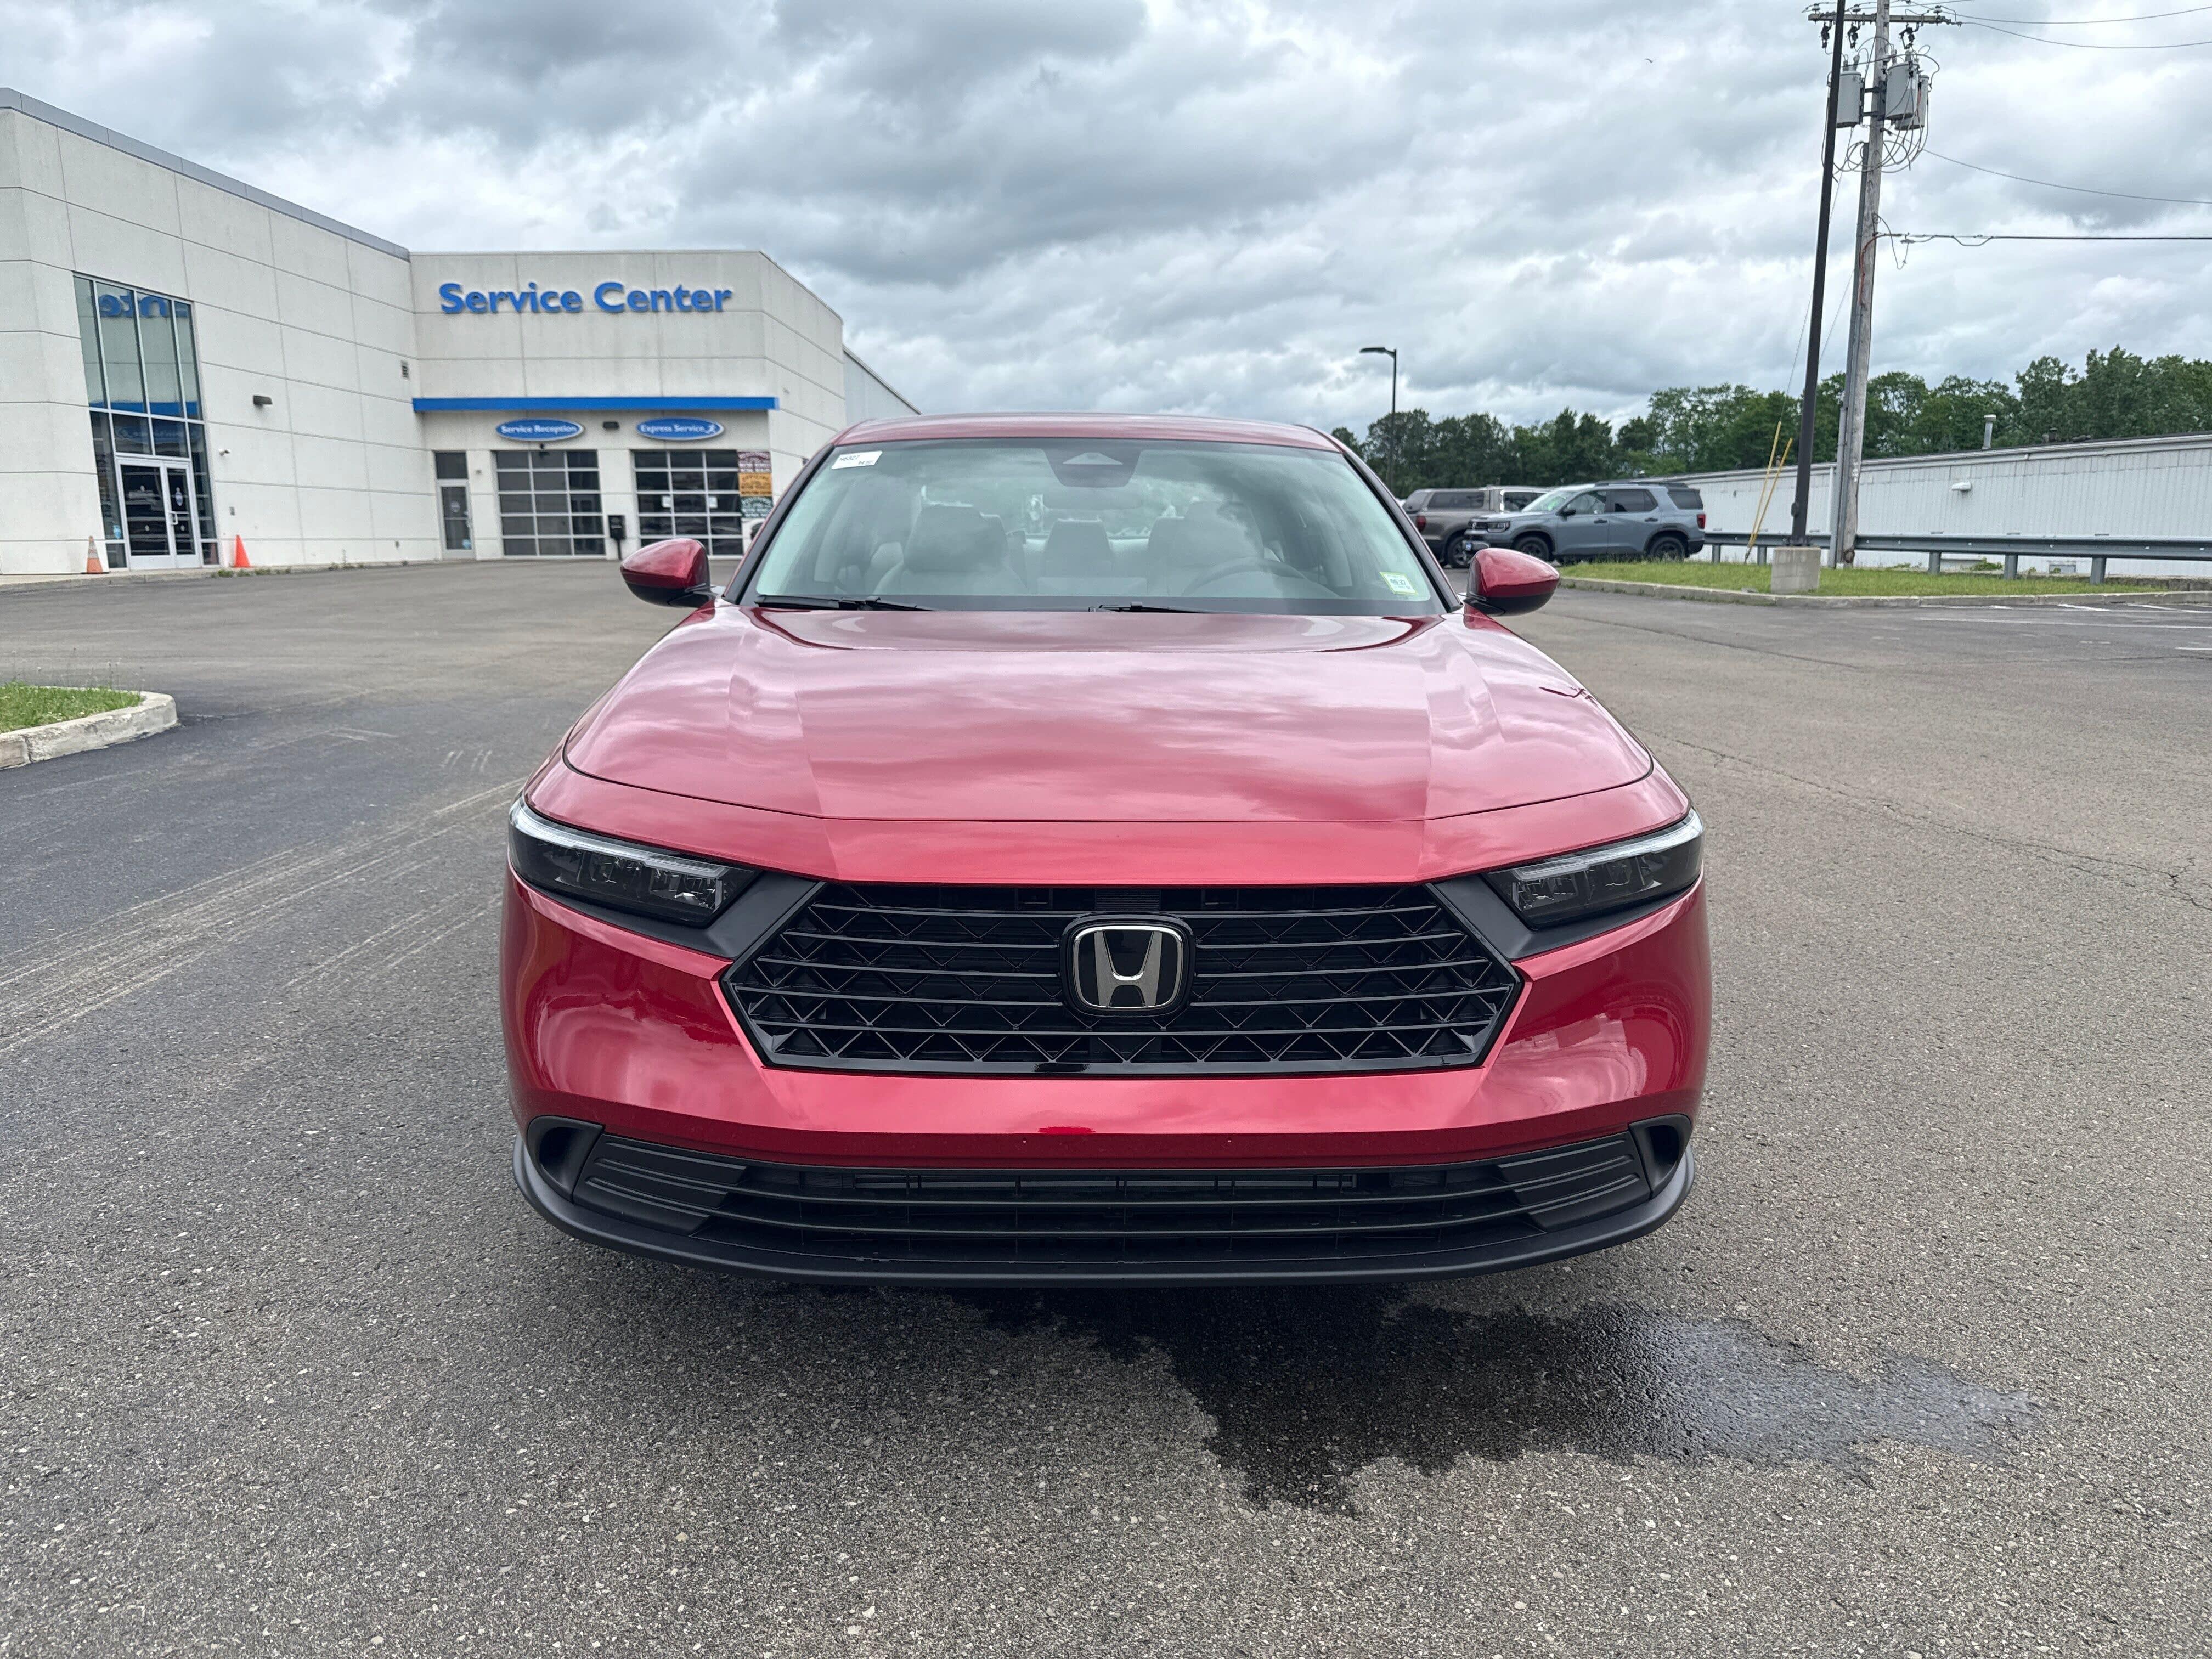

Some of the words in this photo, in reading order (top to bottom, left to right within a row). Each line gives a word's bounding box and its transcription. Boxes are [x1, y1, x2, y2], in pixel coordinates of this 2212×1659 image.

[439, 281, 583, 314] Service
[594, 281, 732, 313] Center
[534, 424, 577, 434] Reception
[640, 424, 673, 434] Express
[673, 424, 705, 432] Service
[1094, 930, 1163, 1007] H
